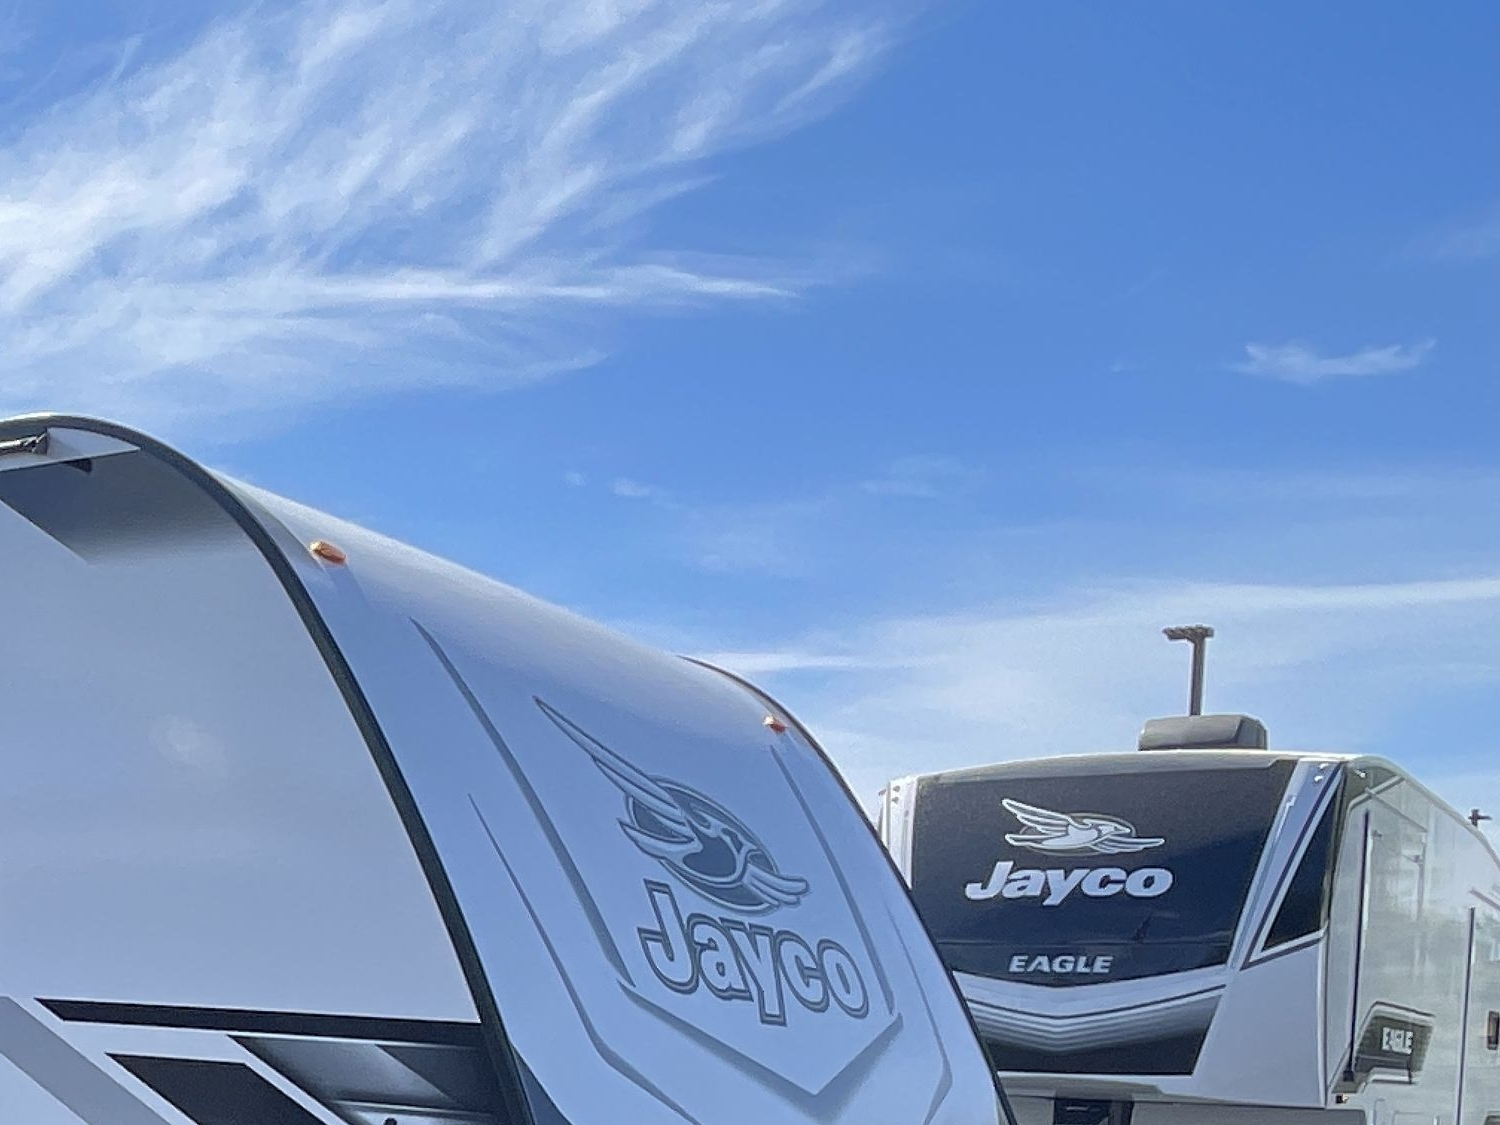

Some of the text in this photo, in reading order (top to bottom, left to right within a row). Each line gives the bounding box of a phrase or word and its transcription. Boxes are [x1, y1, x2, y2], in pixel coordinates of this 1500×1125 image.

[964, 860, 1174, 907] Jayco
[637, 878, 869, 1027] Jayco
[1008, 955, 1115, 974] EAGLE
